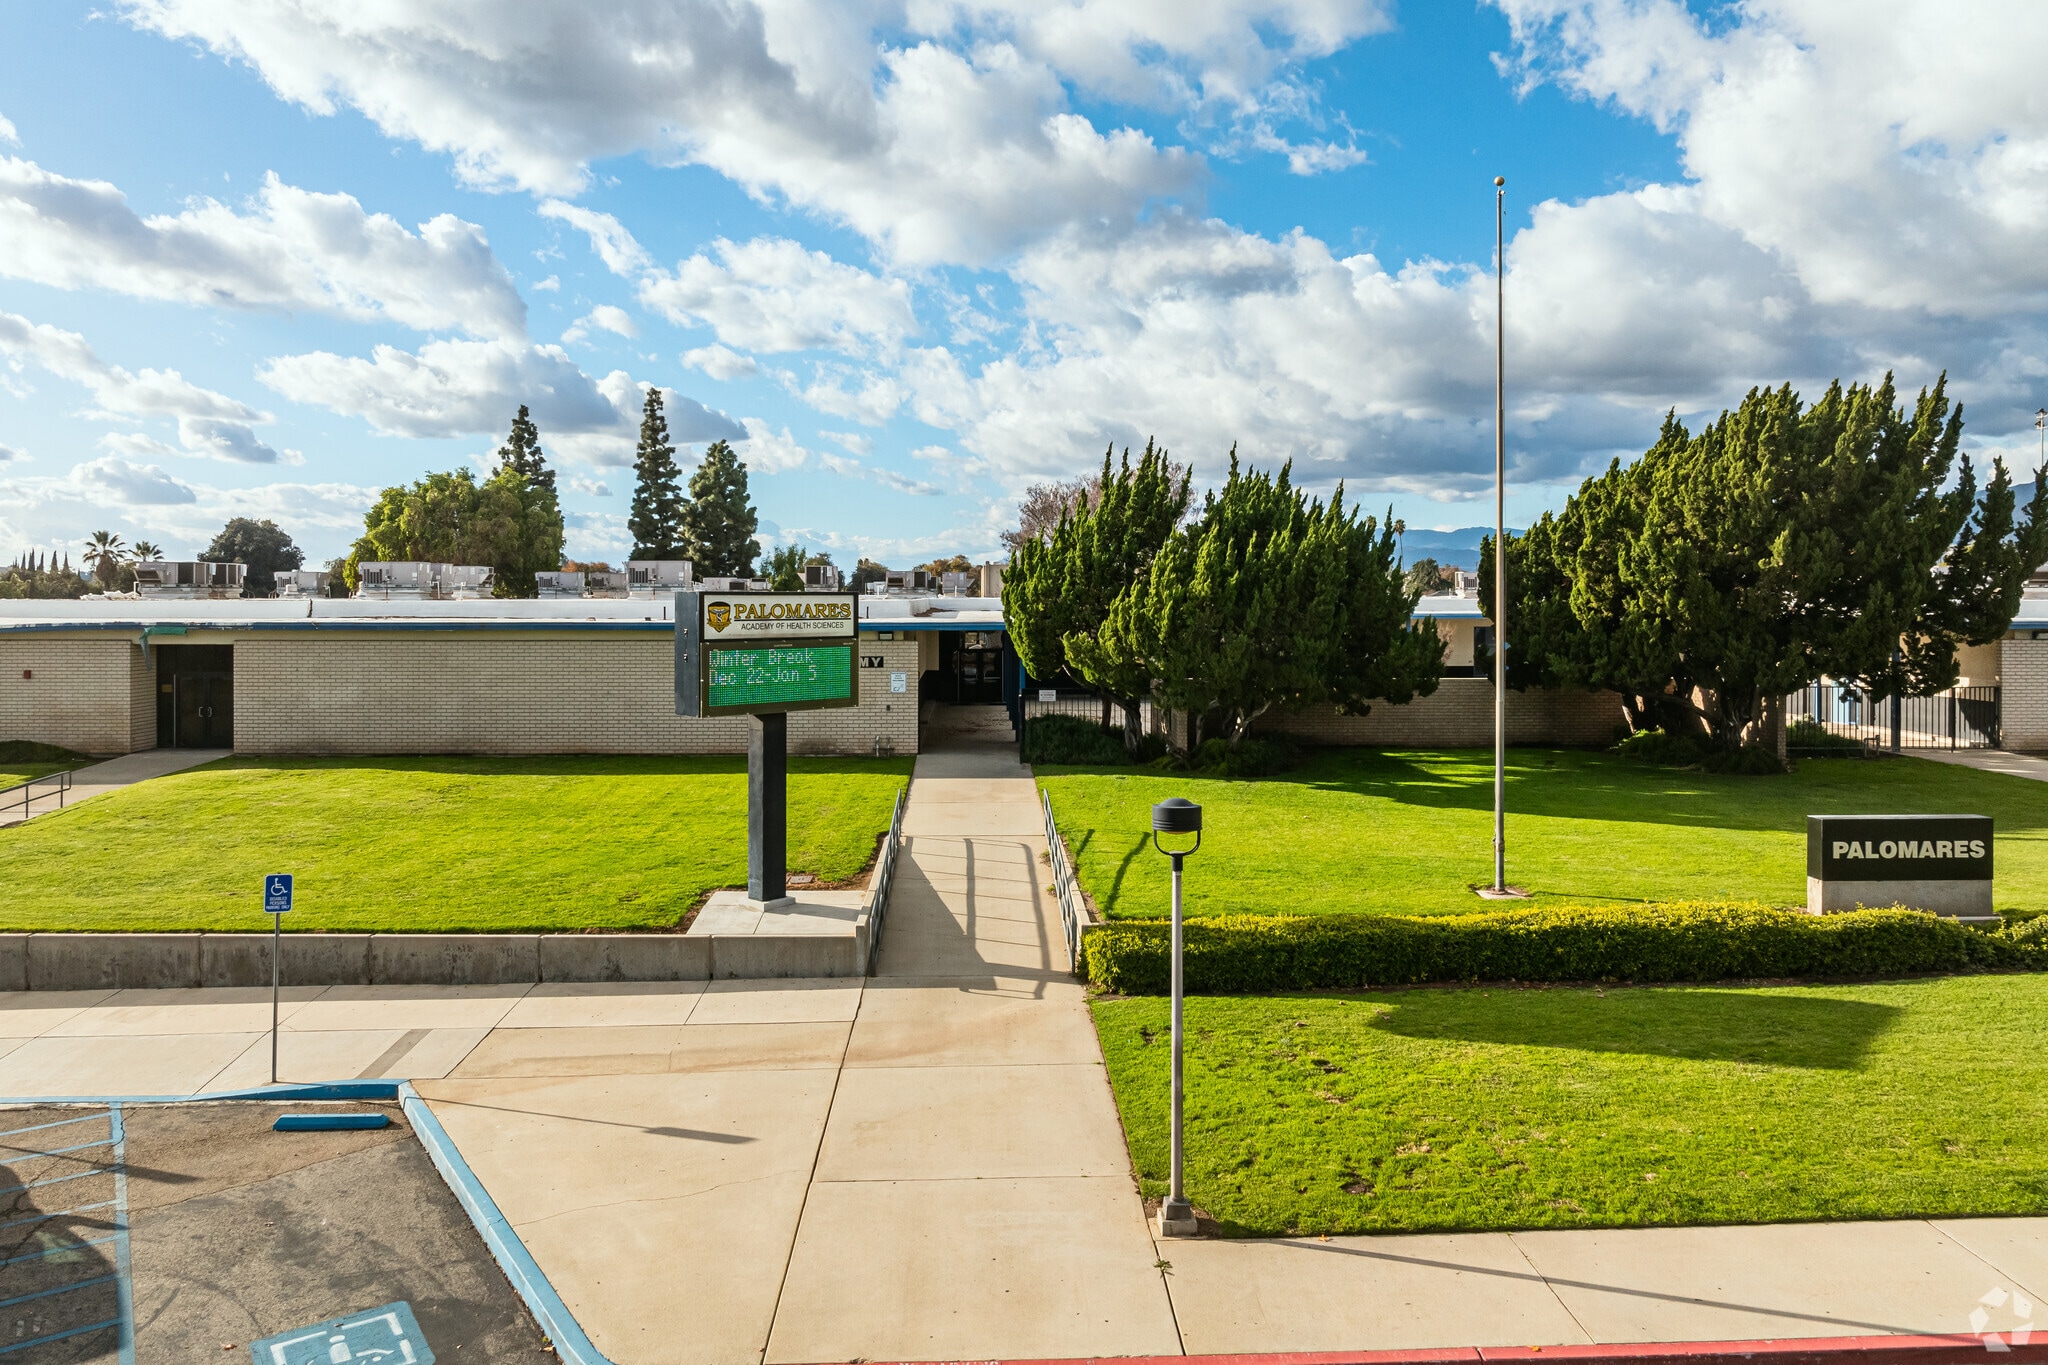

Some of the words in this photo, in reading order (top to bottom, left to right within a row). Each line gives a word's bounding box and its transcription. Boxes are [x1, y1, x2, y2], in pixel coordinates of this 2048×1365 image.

[734, 603, 851, 619] PALOMARES
[741, 623, 774, 631] ACADEMY
[786, 622, 811, 630] HEALTH
[813, 621, 844, 630] SCIENCES
[709, 649, 759, 667] Winter
[768, 648, 814, 665] Break
[709, 669, 737, 685] Dec
[808, 664, 817, 681] 5
[1832, 840, 1986, 859] PALOMARES
